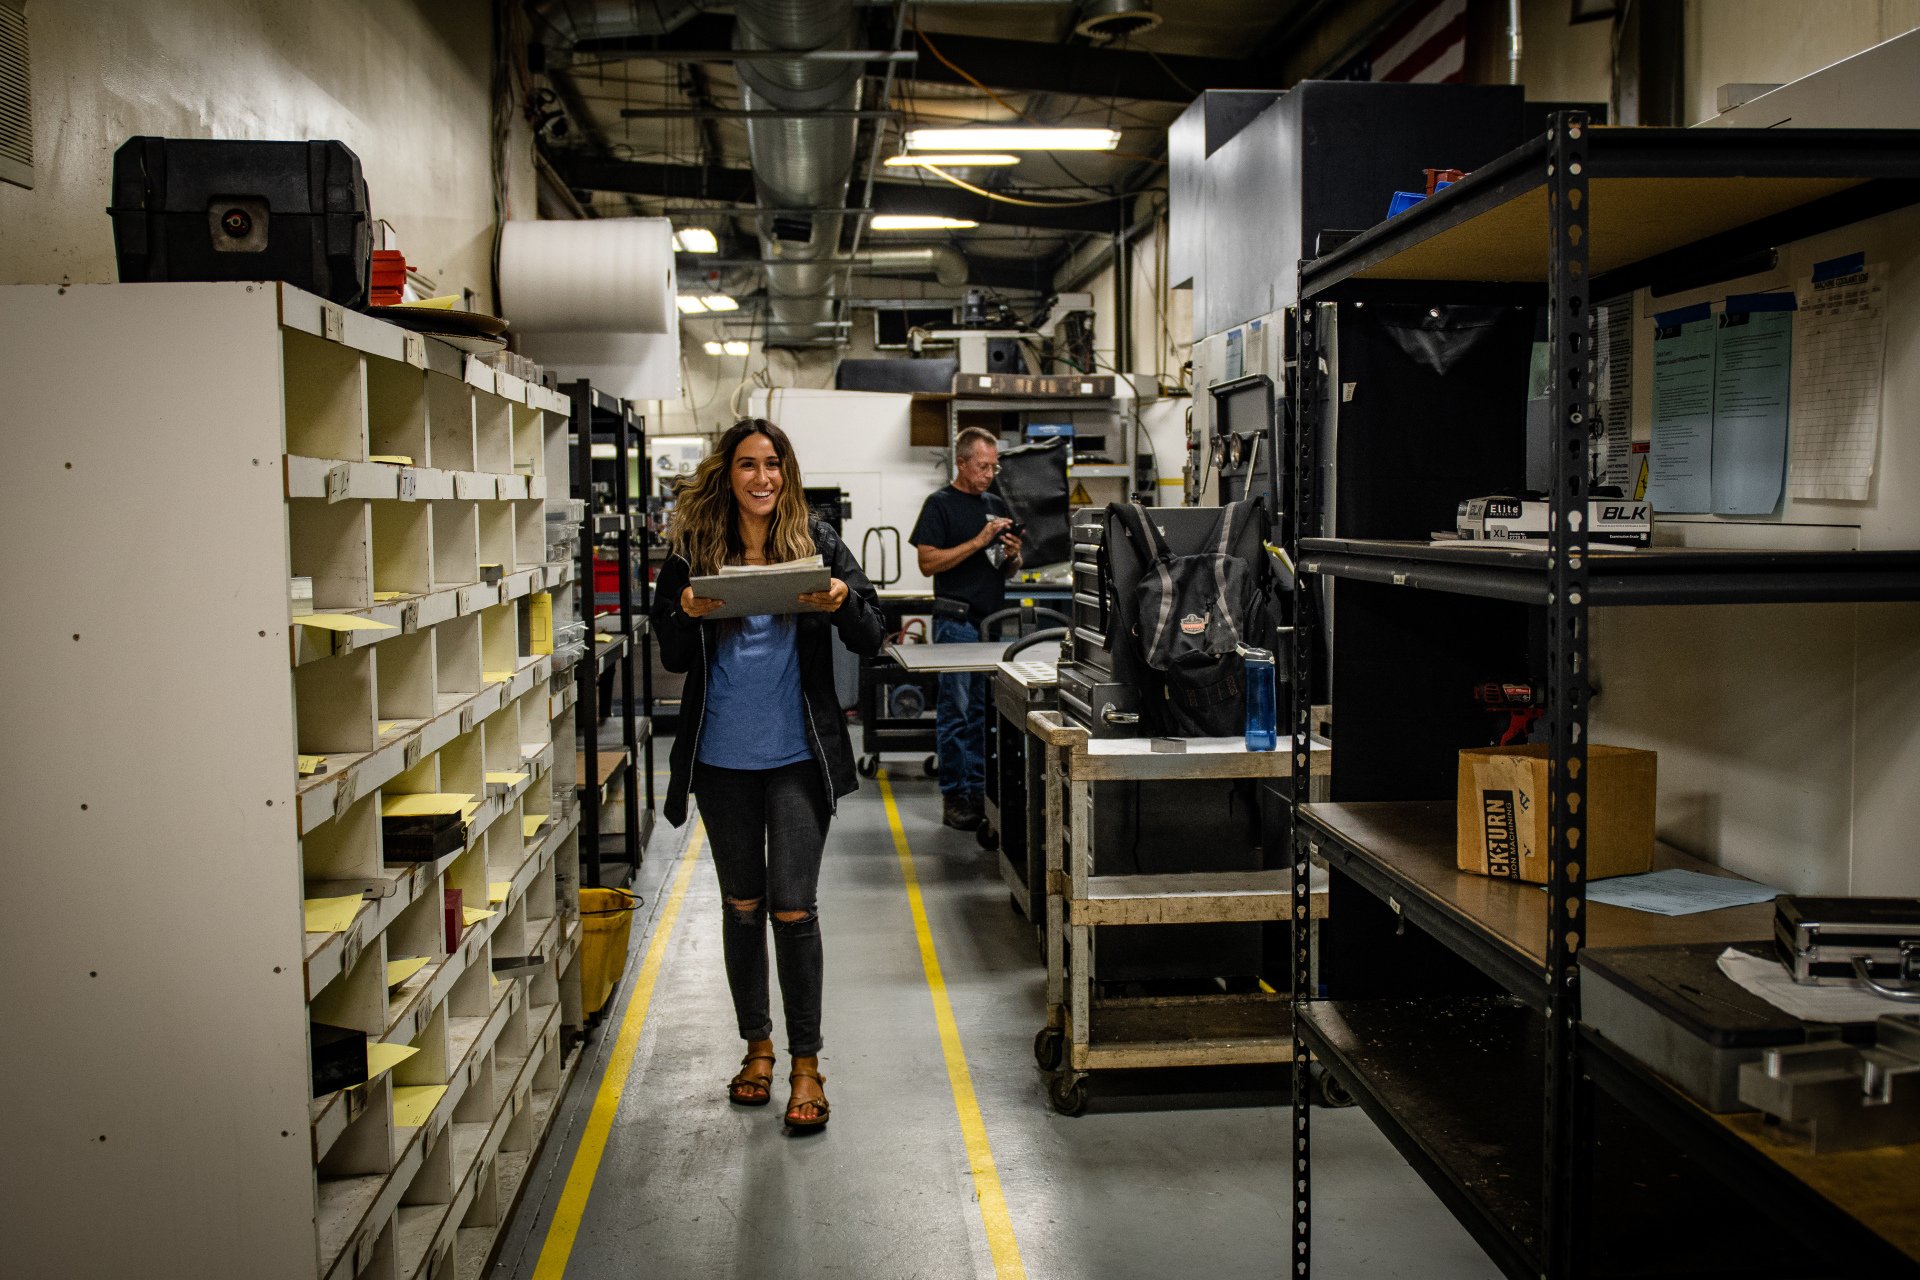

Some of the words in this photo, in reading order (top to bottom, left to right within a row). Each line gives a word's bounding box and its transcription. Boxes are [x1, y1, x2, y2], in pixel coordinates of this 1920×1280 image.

[1489, 504, 1519, 513] Elite
[1602, 506, 1647, 520] BLK
[1493, 529, 1506, 538] XL
[1505, 802, 1516, 855] MACHINING
